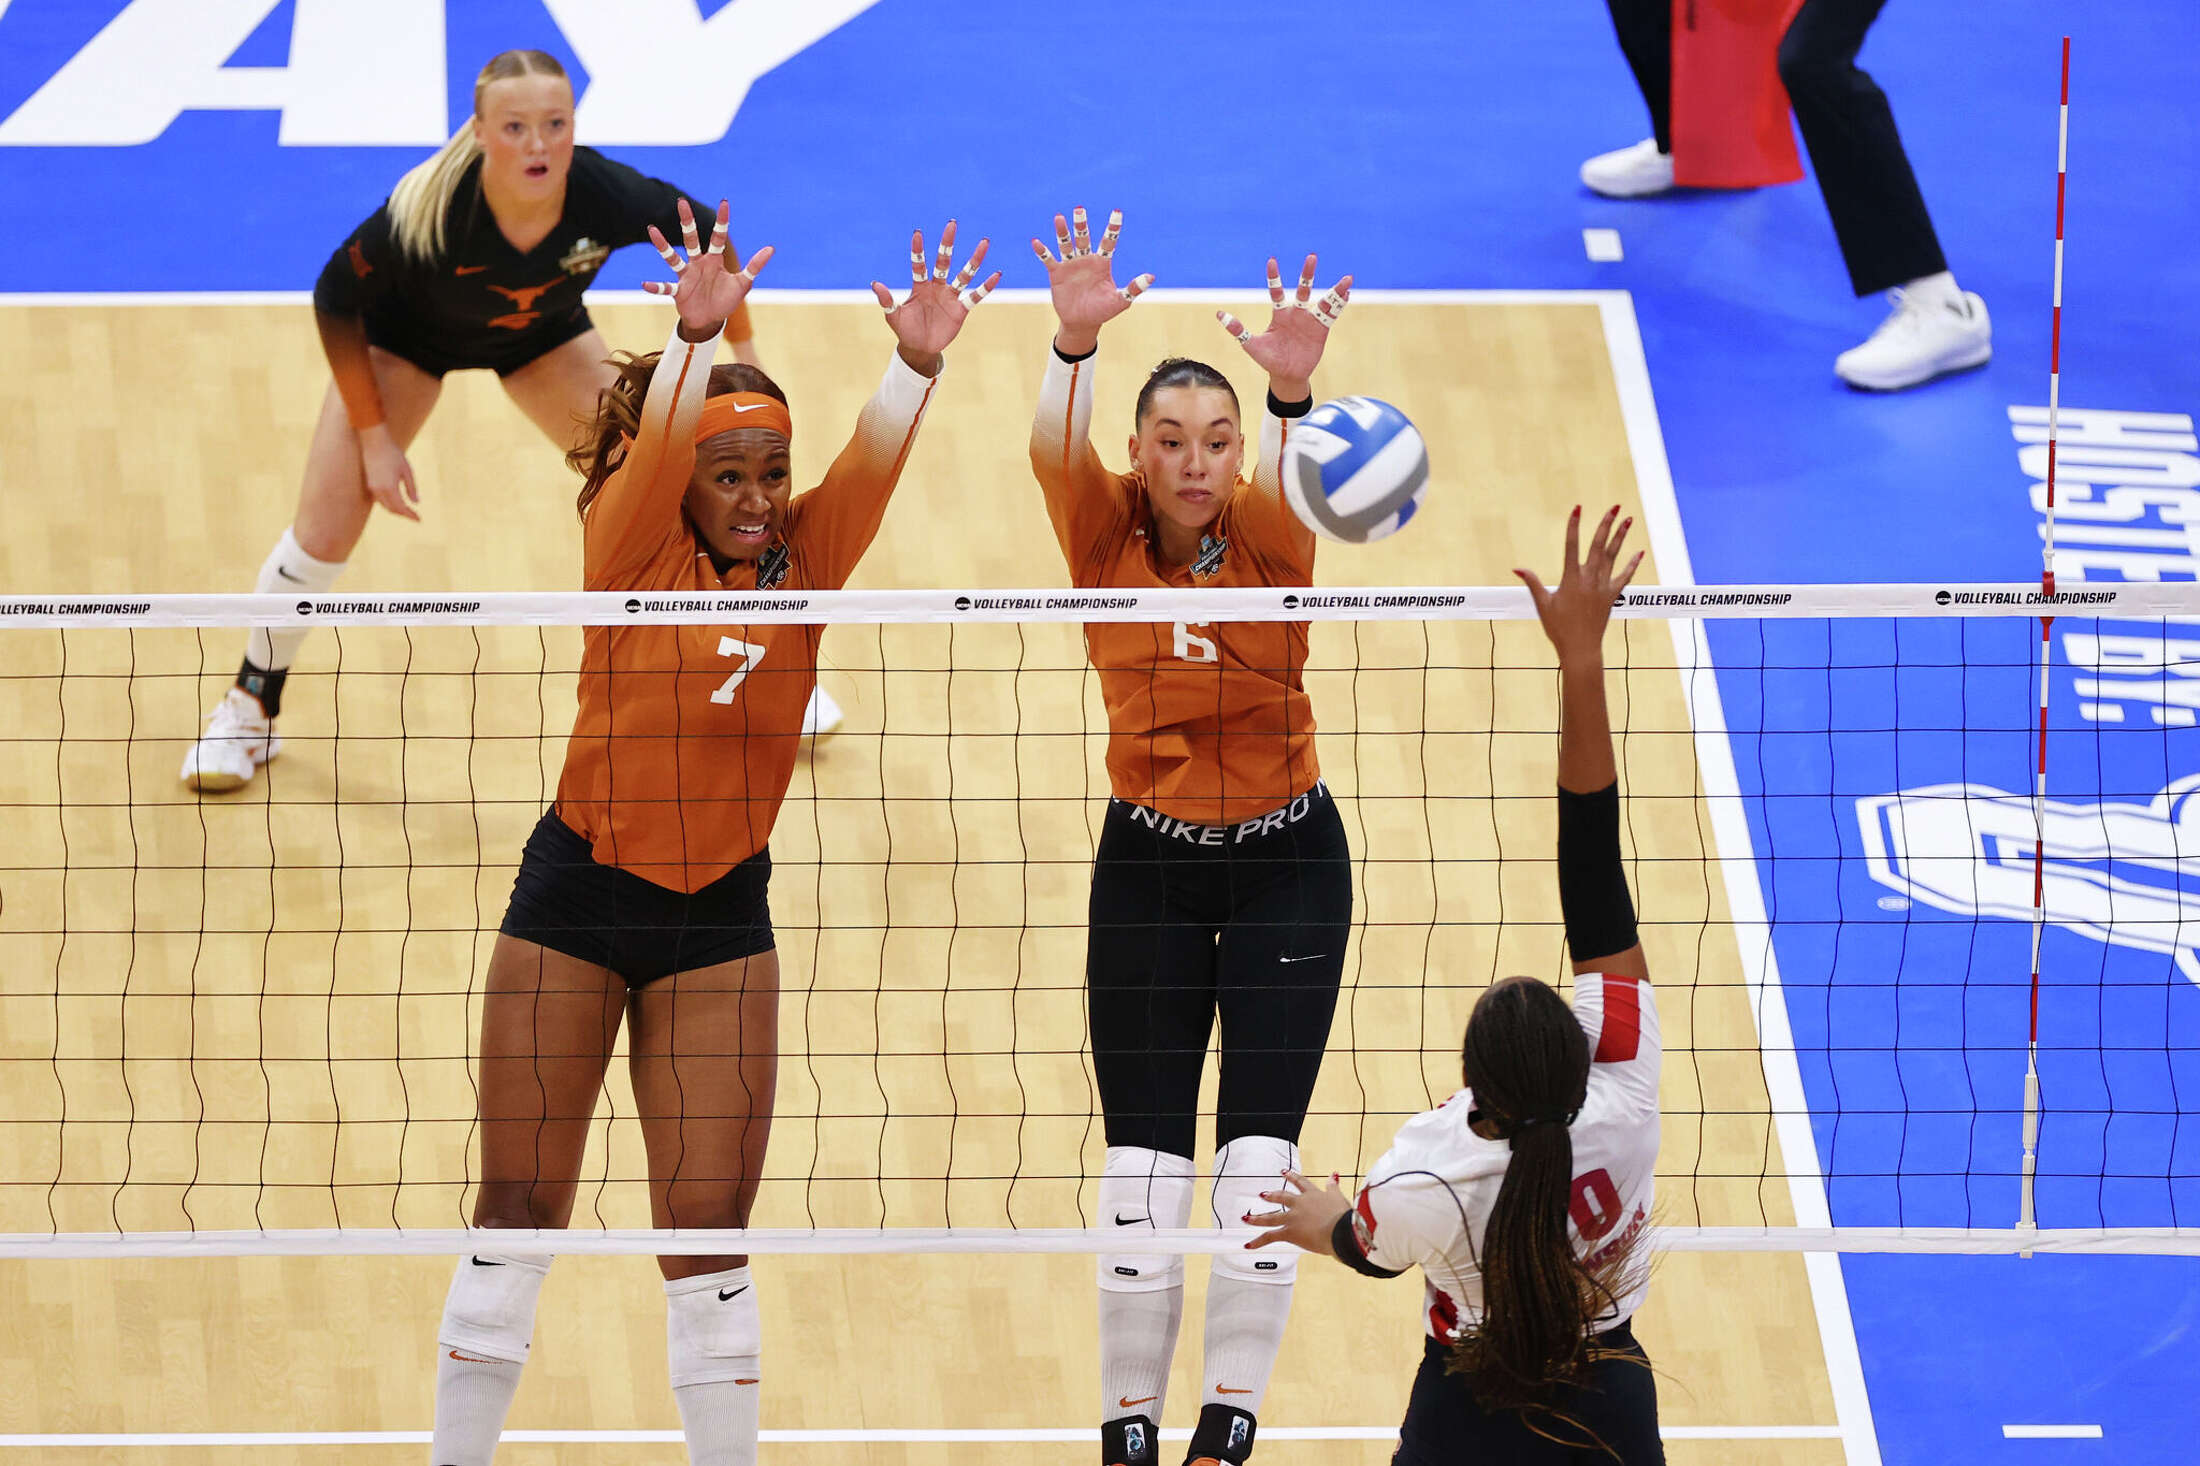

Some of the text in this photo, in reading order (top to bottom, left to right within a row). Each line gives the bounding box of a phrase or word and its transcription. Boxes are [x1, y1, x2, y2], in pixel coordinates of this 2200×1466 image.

[0, 0, 883, 147] AY
[2006, 404, 2200, 726] HOSTE BY:
[974, 598, 1042, 610] VOLLEYBALL
[1046, 597, 1138, 609] CHAMPIONSHIP
[1302, 596, 1370, 608] VOLLEYBALL
[1374, 595, 1465, 607] CHAMPIONSHIP
[1629, 594, 1697, 606] VOLLEYBALL
[1700, 593, 1792, 605] CHAMPIONSHIP
[1954, 592, 2022, 605] VOLLEYBALL
[2026, 592, 2117, 604] CHAMPIONSHIP
[0, 603, 151, 615] LLEYBALL CHAMPIONSHIP
[316, 602, 384, 614] VOLLEYBALL
[388, 601, 480, 613] CHAMPIONSHIP
[644, 600, 712, 612] VOLLEYBALL
[716, 599, 808, 611] CHAMPIONSHIP
[1172, 621, 1219, 663] 6
[709, 635, 767, 705] 7
[1129, 792, 1310, 846] NIKE PRO
